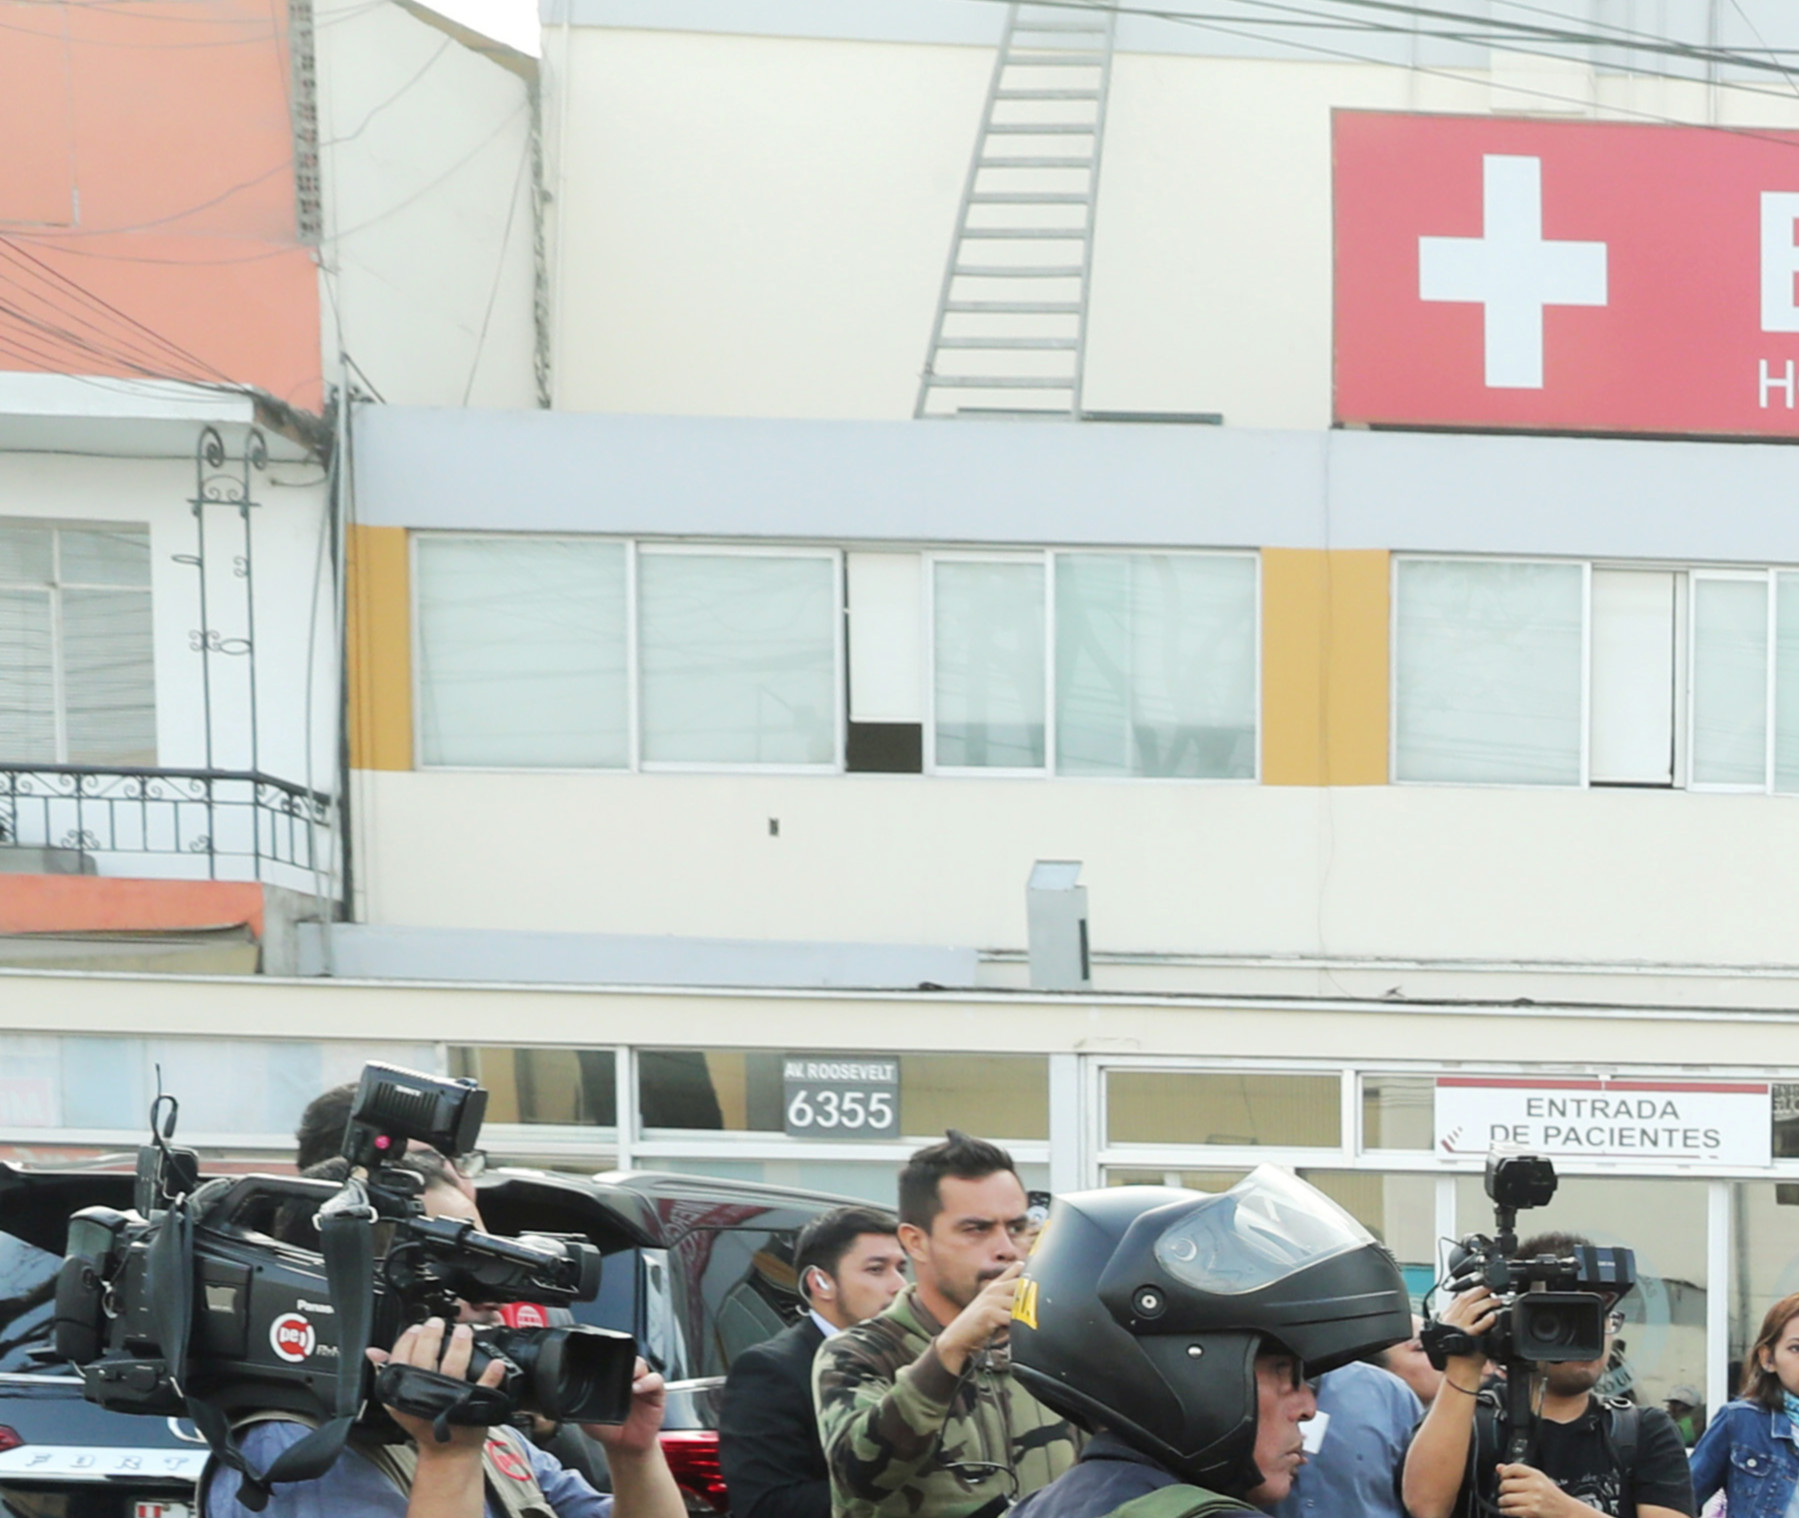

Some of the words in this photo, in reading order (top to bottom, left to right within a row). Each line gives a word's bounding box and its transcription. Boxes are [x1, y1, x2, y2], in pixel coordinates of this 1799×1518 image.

[806, 1062, 895, 1081] ROOSEVELT
[787, 1090, 893, 1130] 6355
[1525, 1097, 1681, 1120] ENTRADA
[1489, 1124, 1531, 1145] DE
[1542, 1125, 1722, 1149] PACIENTES
